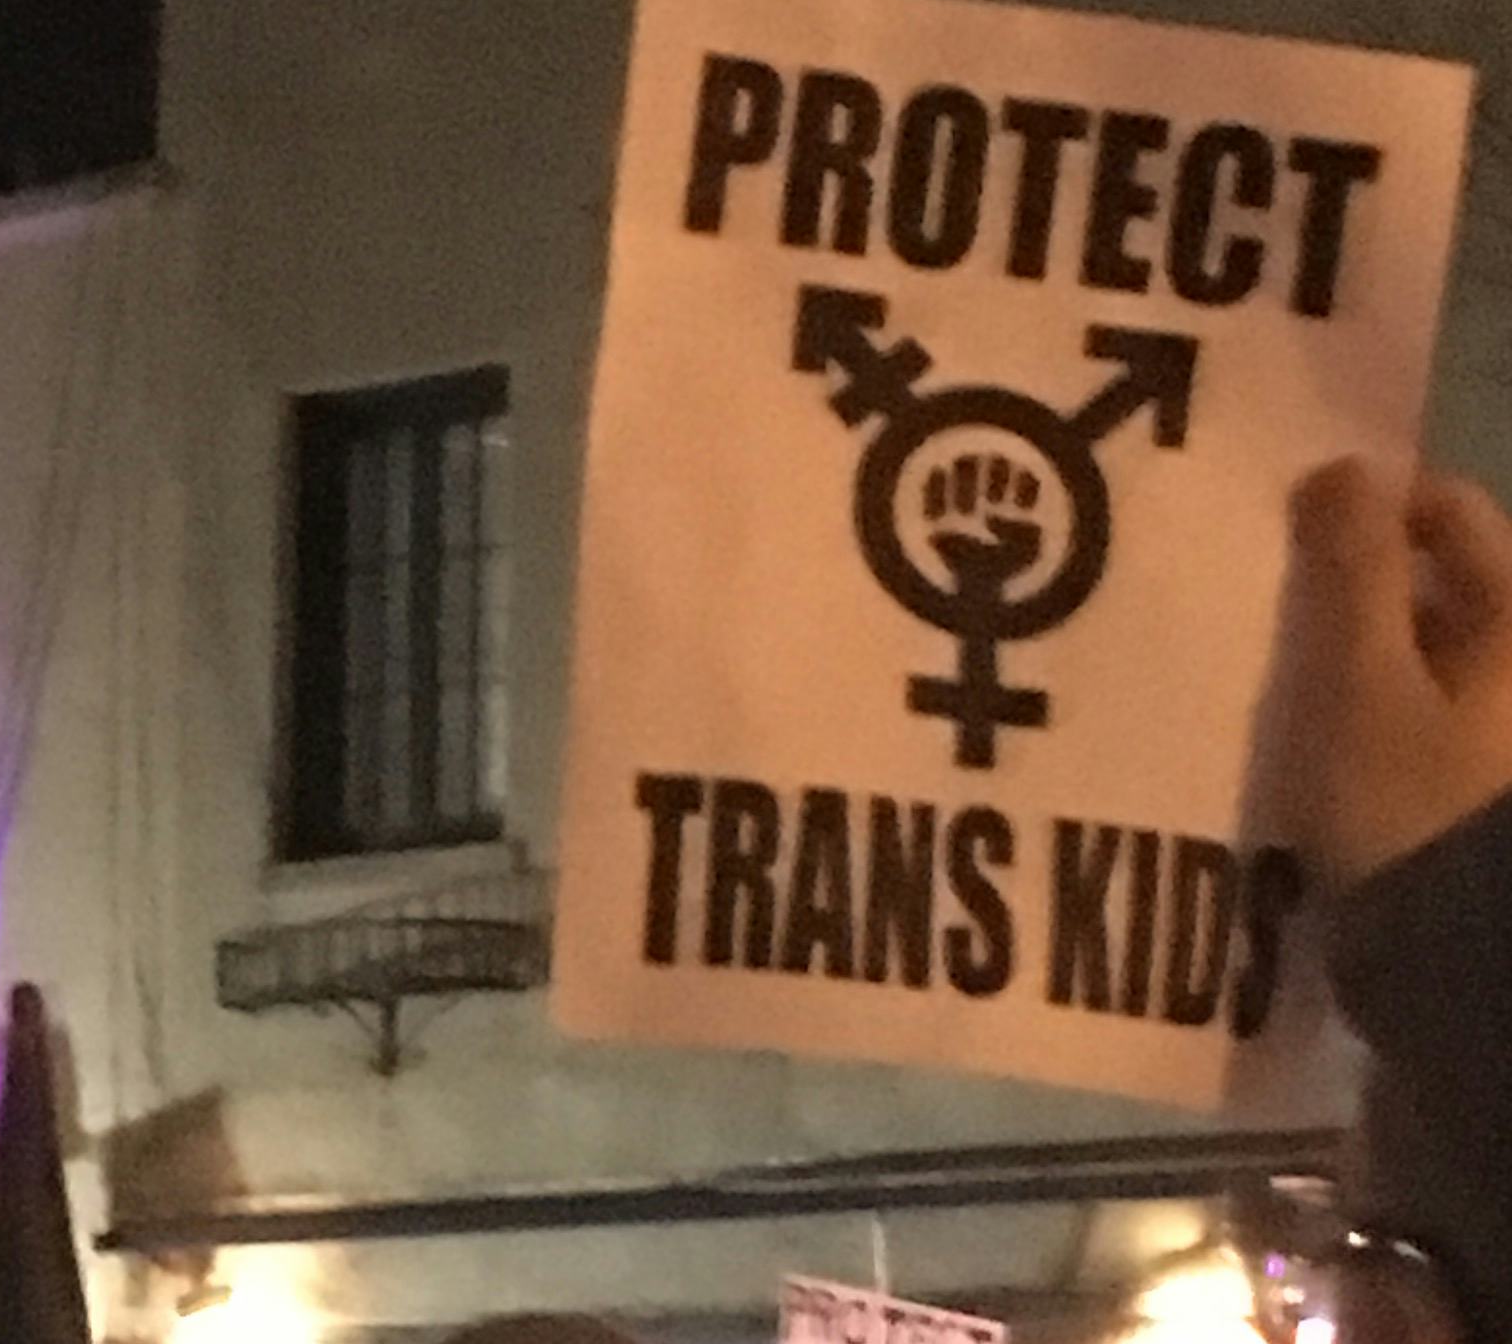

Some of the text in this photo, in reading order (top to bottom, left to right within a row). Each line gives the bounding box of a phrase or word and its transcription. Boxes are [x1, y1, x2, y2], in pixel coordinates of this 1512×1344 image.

[684, 52, 1384, 320] PROTECT
[635, 771, 1299, 1040] TRANS KIDS
